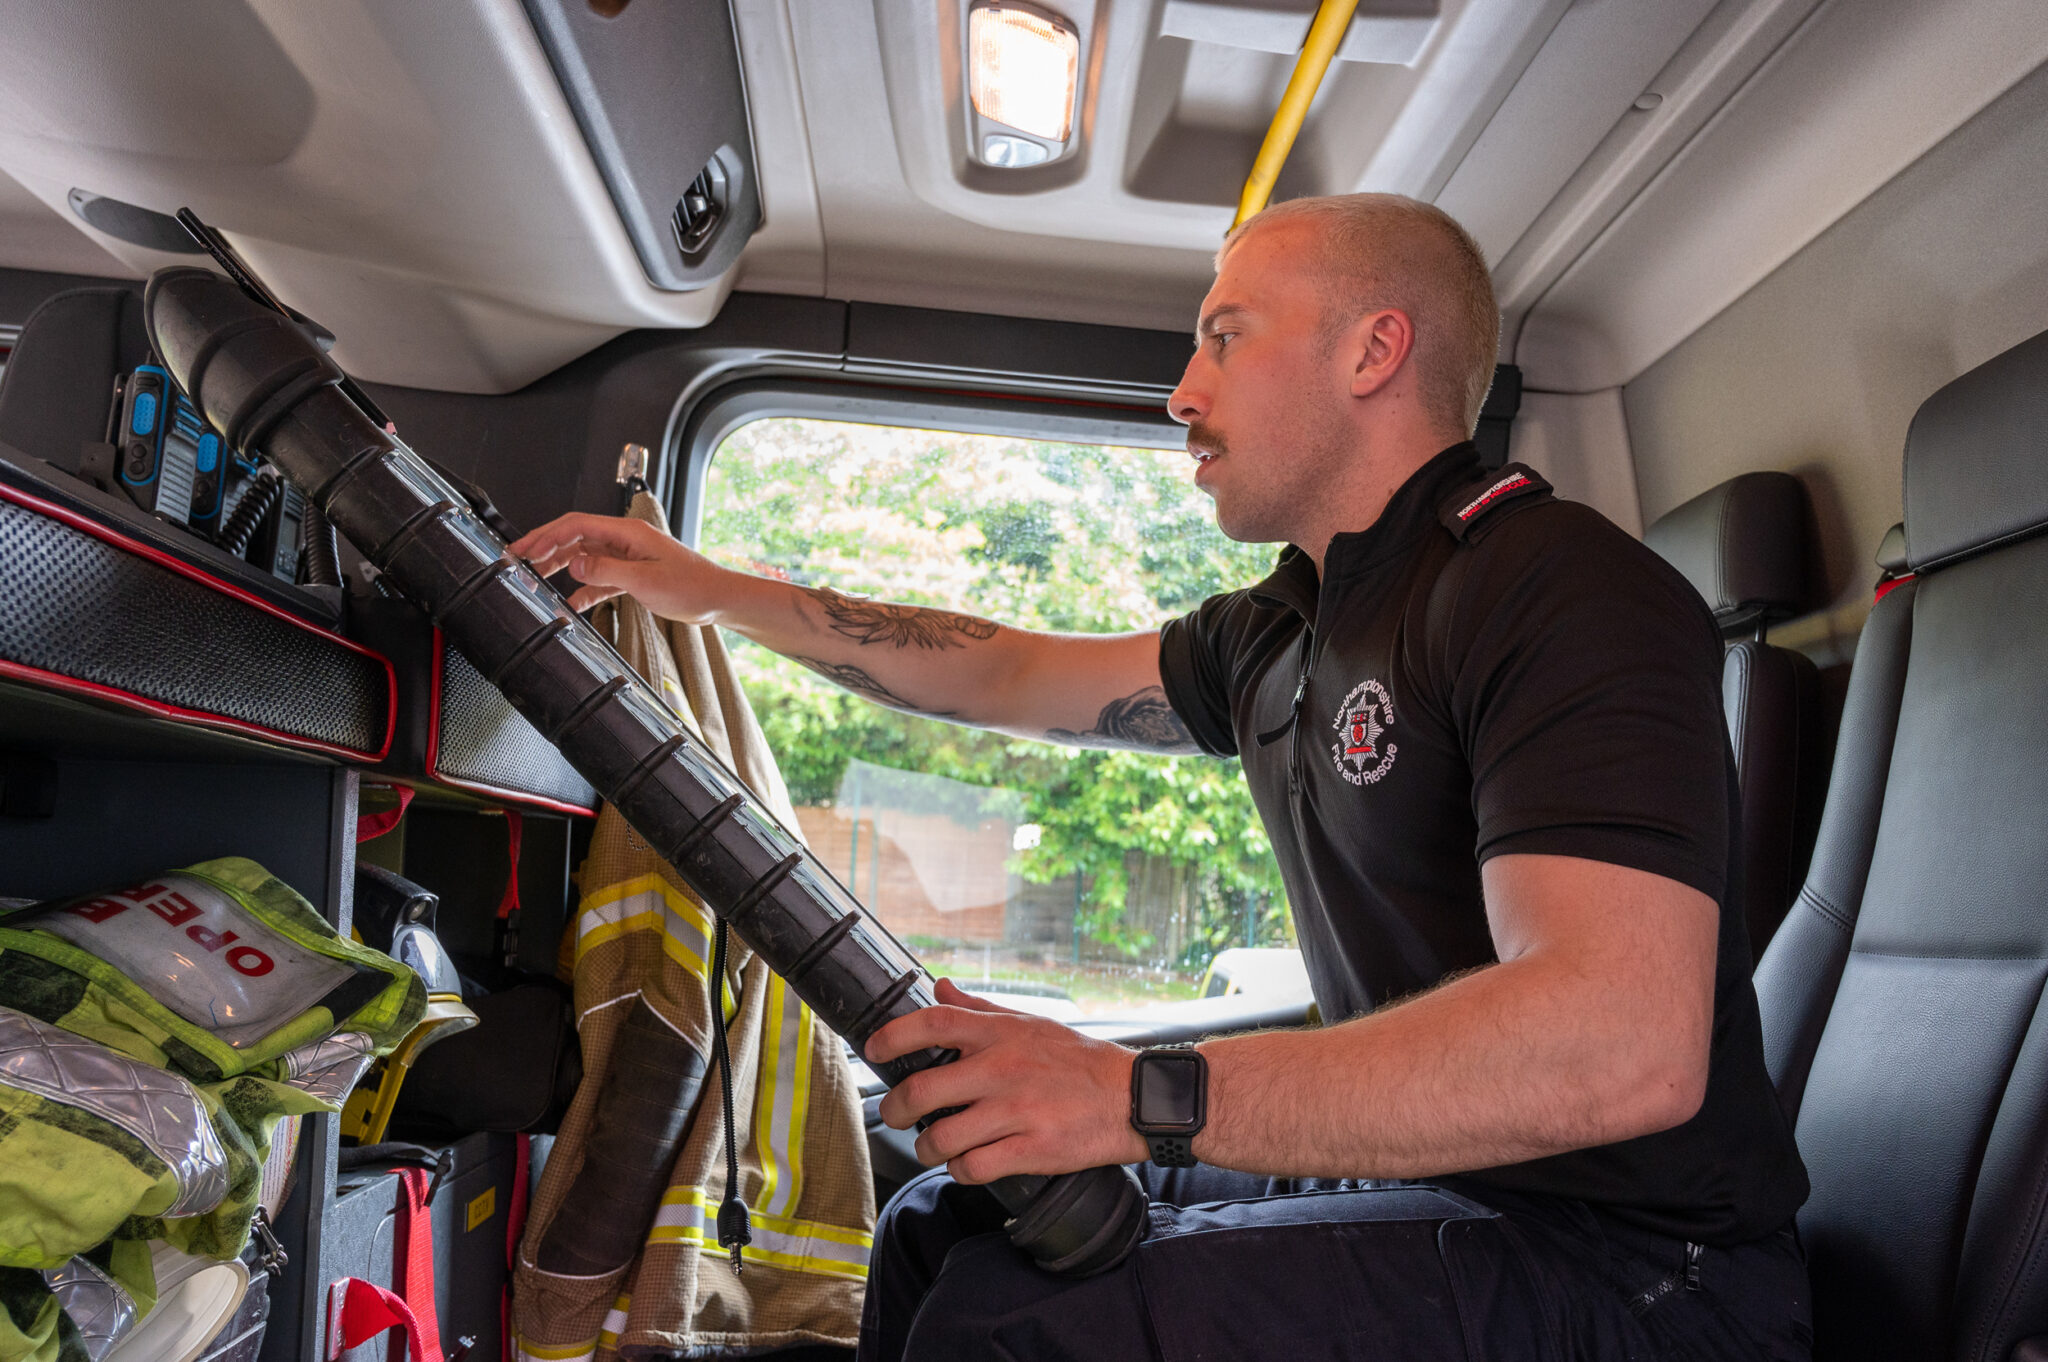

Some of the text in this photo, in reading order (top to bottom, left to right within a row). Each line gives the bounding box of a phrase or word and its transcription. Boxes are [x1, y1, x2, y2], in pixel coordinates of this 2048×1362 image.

[1332, 679, 1395, 730] Northamptonshire
[1331, 743, 1398, 785] Fire and Rescue
